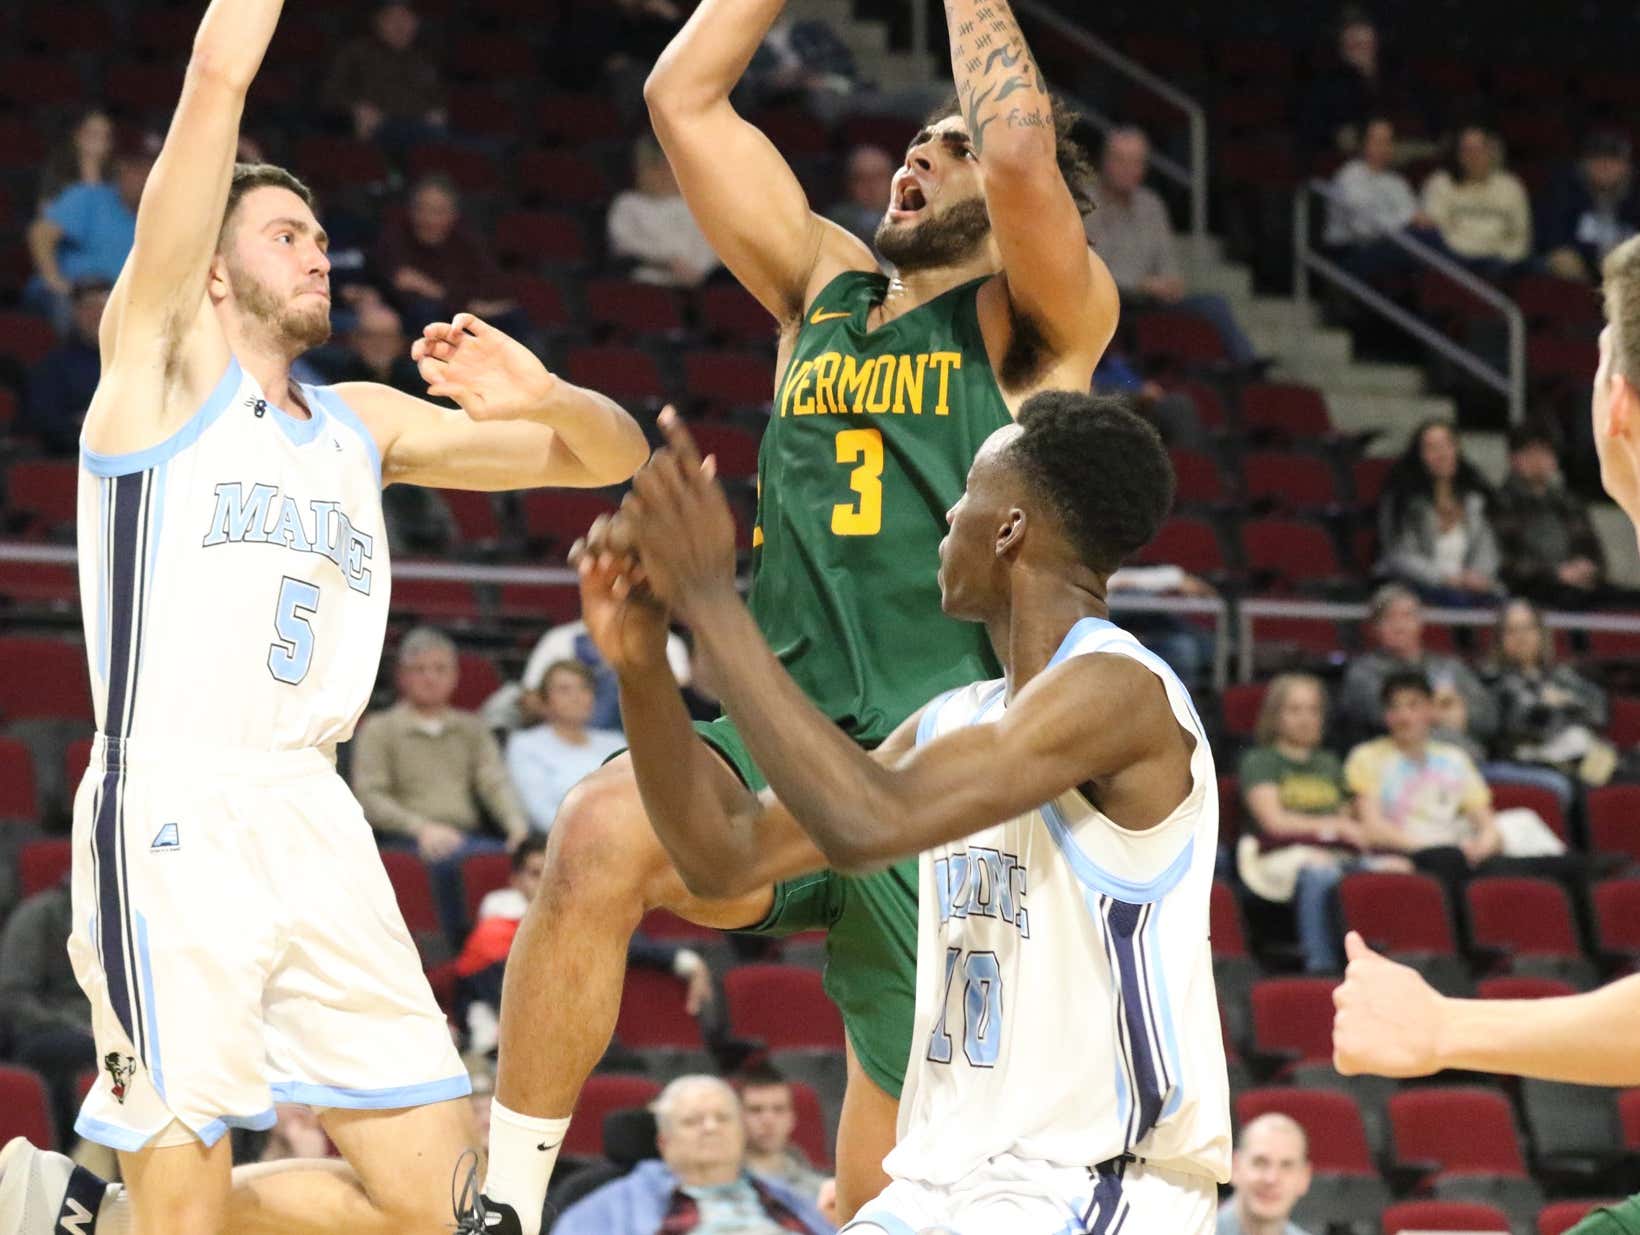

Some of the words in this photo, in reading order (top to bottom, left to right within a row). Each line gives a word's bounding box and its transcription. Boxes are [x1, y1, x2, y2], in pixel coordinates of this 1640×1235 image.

[780, 351, 961, 418] VERMONT
[830, 428, 884, 536] 3
[267, 575, 321, 686] 5
[926, 946, 1004, 1068] 10
